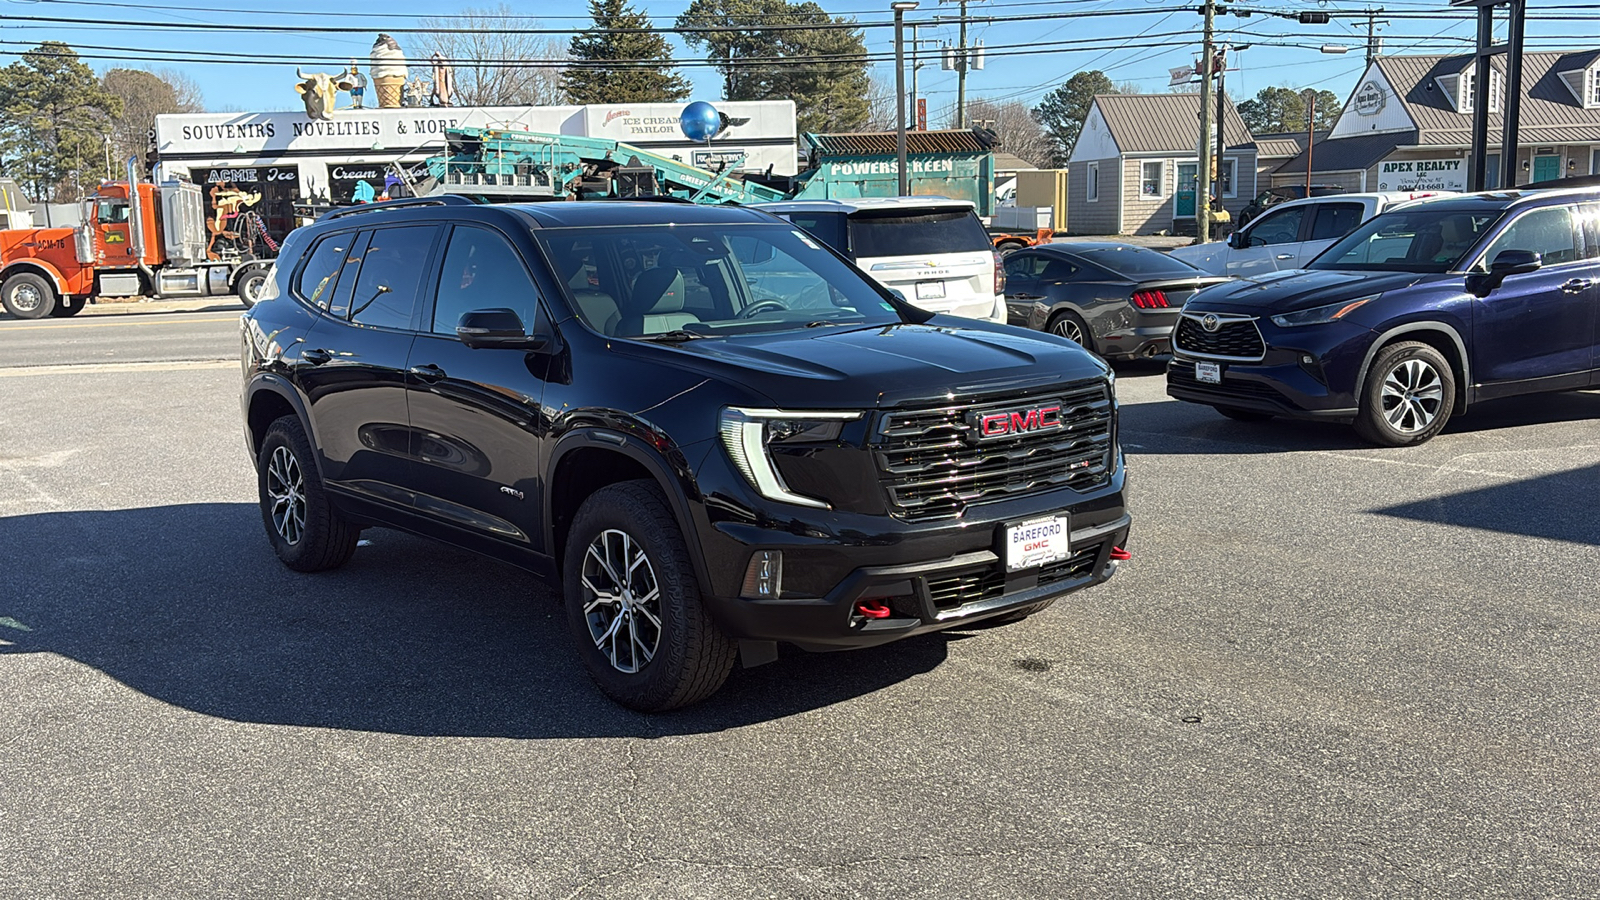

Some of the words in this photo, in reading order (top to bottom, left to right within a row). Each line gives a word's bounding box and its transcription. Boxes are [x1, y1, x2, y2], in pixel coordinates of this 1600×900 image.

[623, 117, 641, 126] ICE
[182, 122, 275, 140] SOUVENIRS
[293, 120, 380, 137] NOVELTIES
[397, 120, 408, 134] &
[631, 126, 675, 134] PARLOR
[1383, 162, 1413, 173] APEX
[1416, 160, 1460, 171] REALTY
[208, 169, 258, 183] ACME
[266, 168, 296, 181] Ice
[332, 166, 377, 180] Cream
[982, 406, 1061, 435] GMC
[500, 486, 525, 500] AT4
[1013, 523, 1061, 543] BAREFORD
[1024, 539, 1049, 552] GMC
